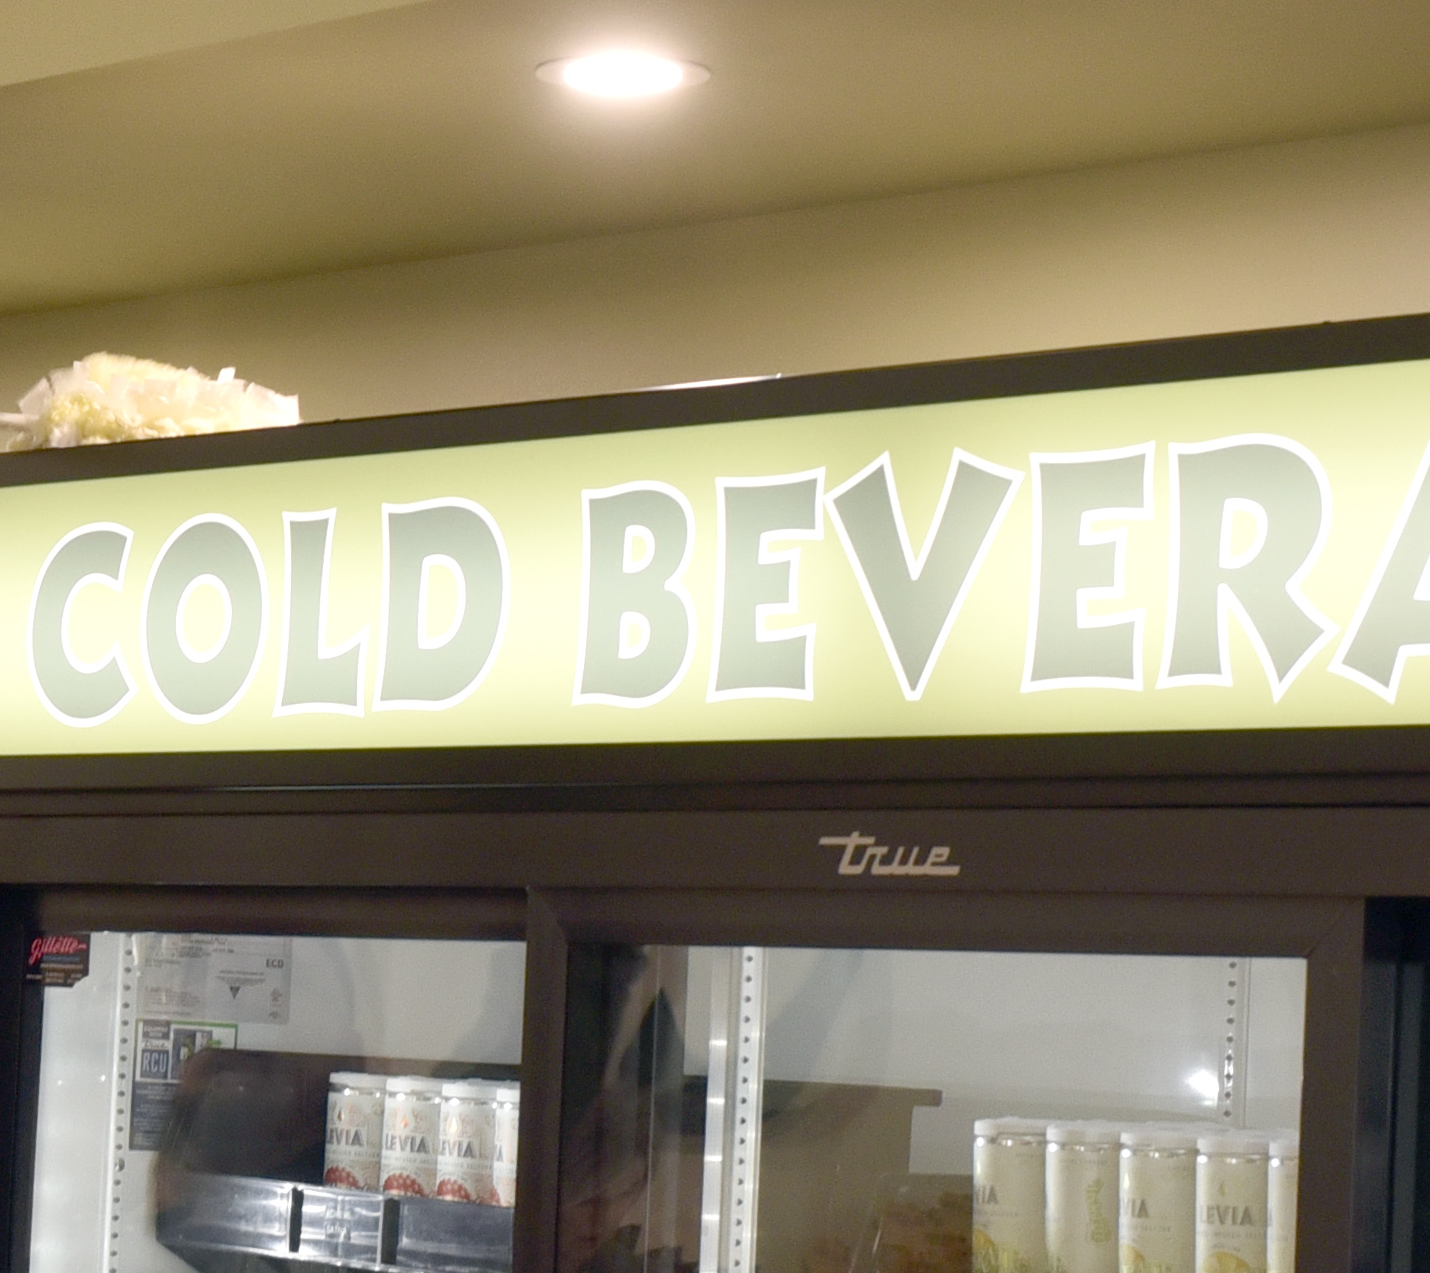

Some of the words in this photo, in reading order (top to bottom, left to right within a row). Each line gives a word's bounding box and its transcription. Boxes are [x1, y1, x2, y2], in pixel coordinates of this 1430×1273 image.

[30, 501, 507, 731] COLD
[816, 832, 962, 878] true
[385, 1133, 429, 1154] LEVIA
